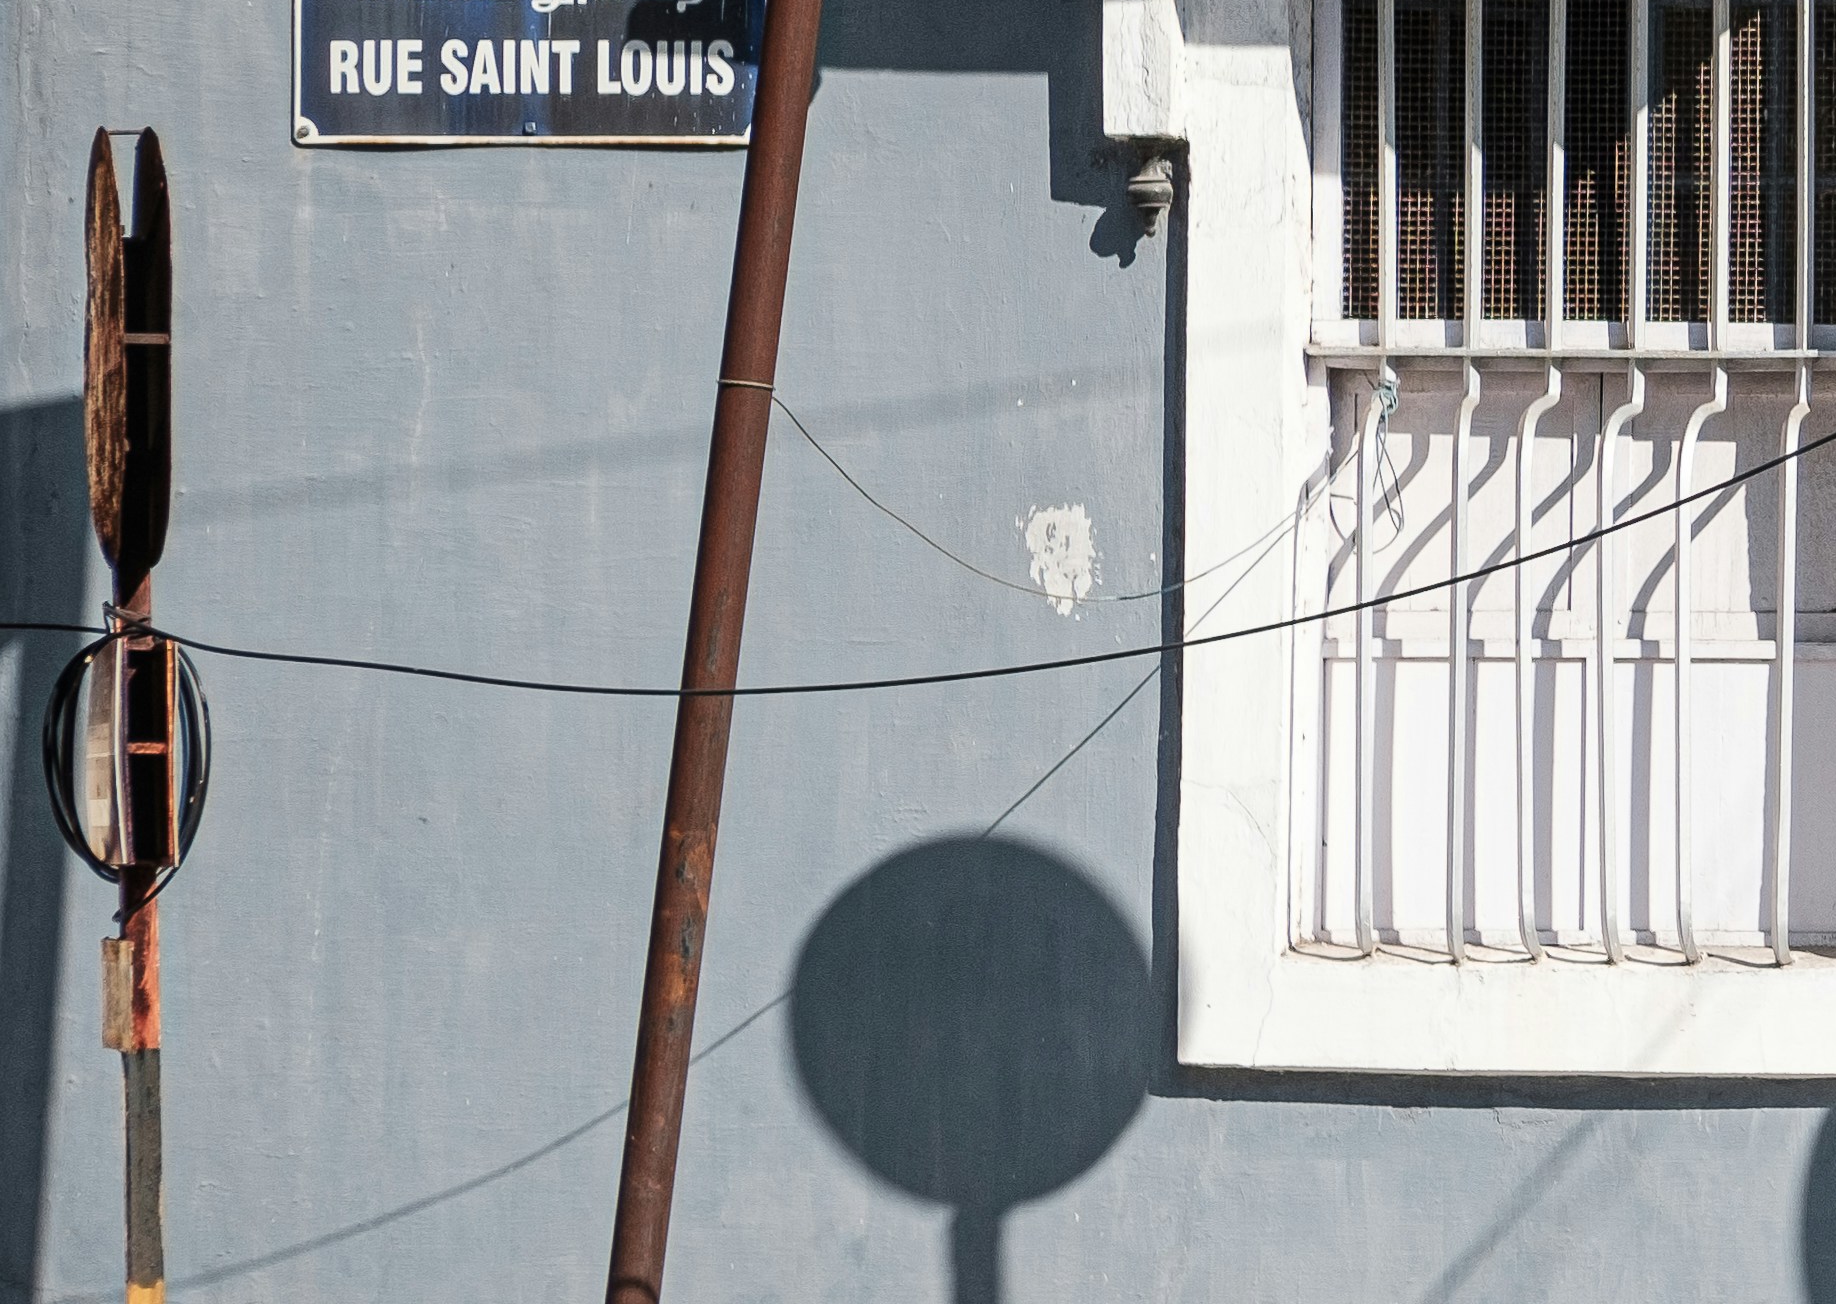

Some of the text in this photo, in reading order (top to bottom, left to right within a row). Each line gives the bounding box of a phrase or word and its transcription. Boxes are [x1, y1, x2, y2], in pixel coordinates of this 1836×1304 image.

[329, 39, 736, 97] RUE SAINT LOUIS
